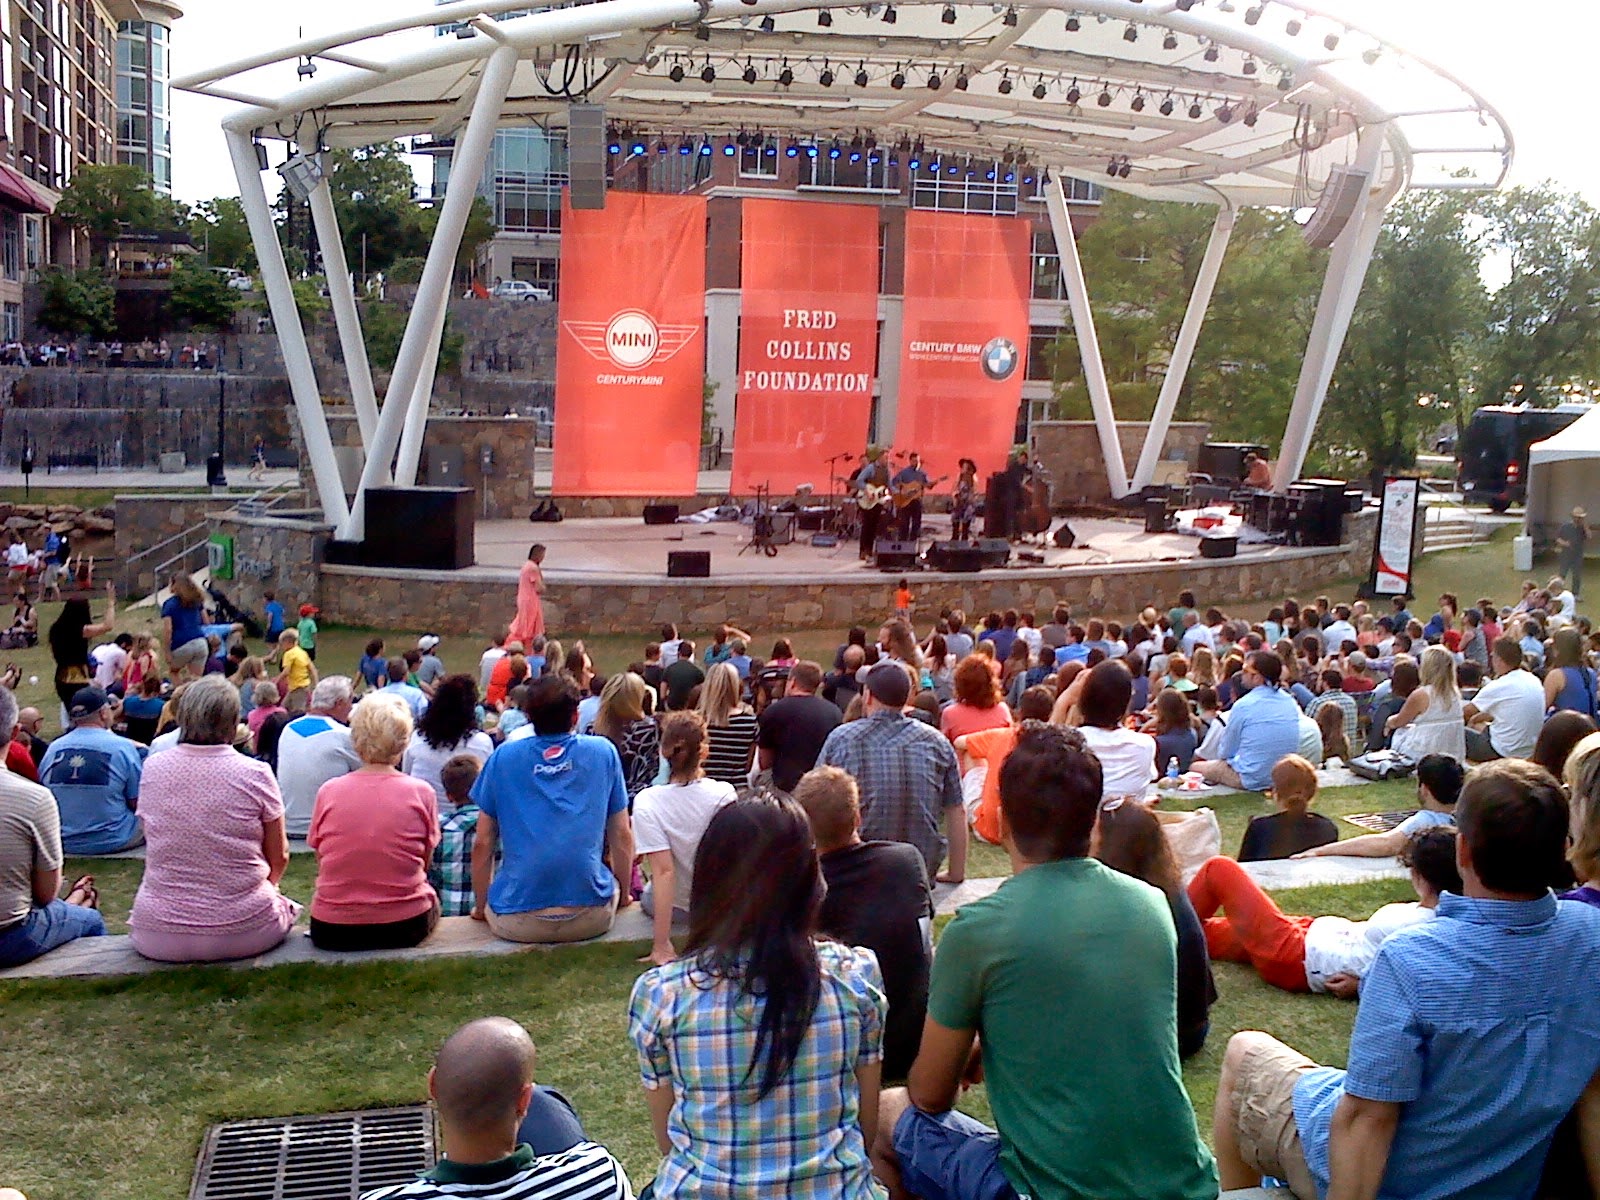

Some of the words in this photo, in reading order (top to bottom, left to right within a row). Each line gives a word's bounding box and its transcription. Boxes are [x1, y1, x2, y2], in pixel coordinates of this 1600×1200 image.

[783, 309, 837, 329] FRED
[612, 332, 652, 347] MINI
[909, 341, 955, 353] CENTURY
[956, 343, 982, 354] BMW
[766, 340, 851, 361] COLLINS
[743, 370, 869, 392] FOUNDATION
[533, 759, 573, 775] pepsi
